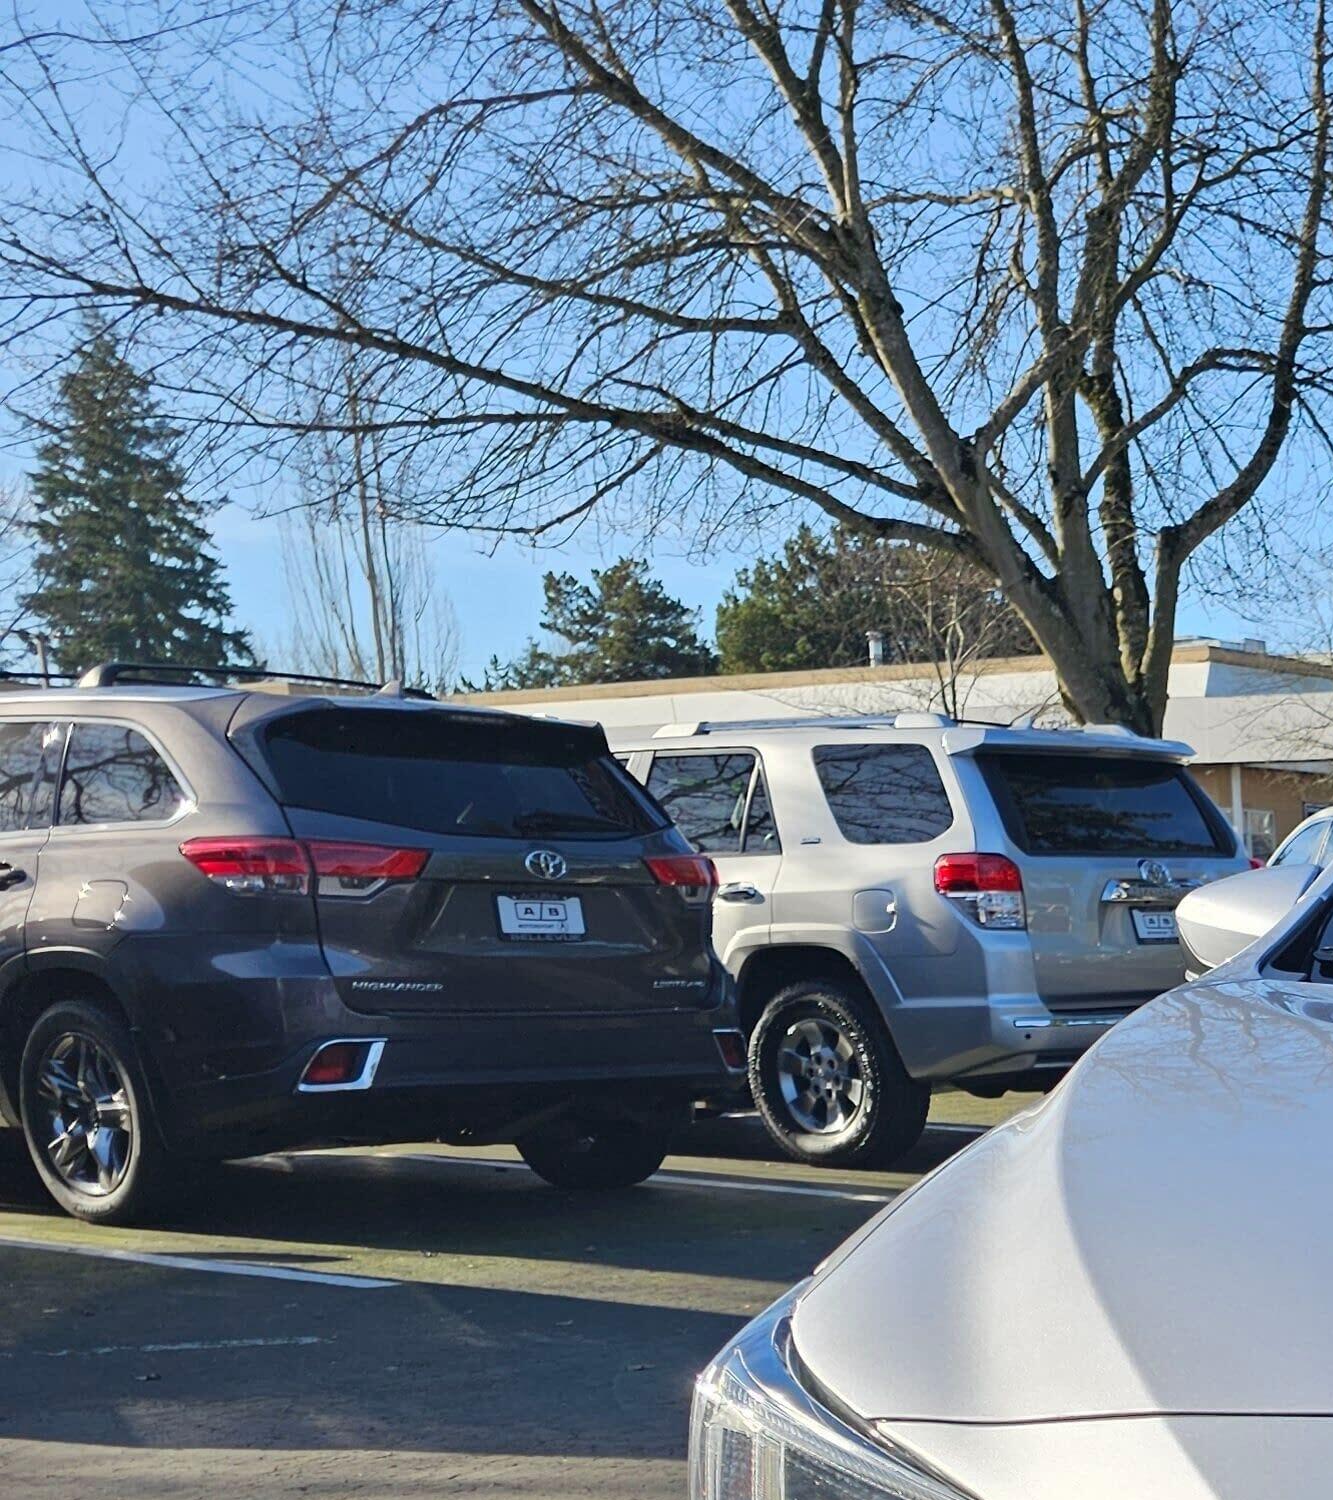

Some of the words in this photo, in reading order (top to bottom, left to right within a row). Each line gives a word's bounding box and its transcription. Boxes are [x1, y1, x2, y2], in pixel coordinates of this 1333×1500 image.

[523, 907, 535, 916] A
[548, 907, 560, 917] B
[351, 980, 444, 992] HIGHLANDER
